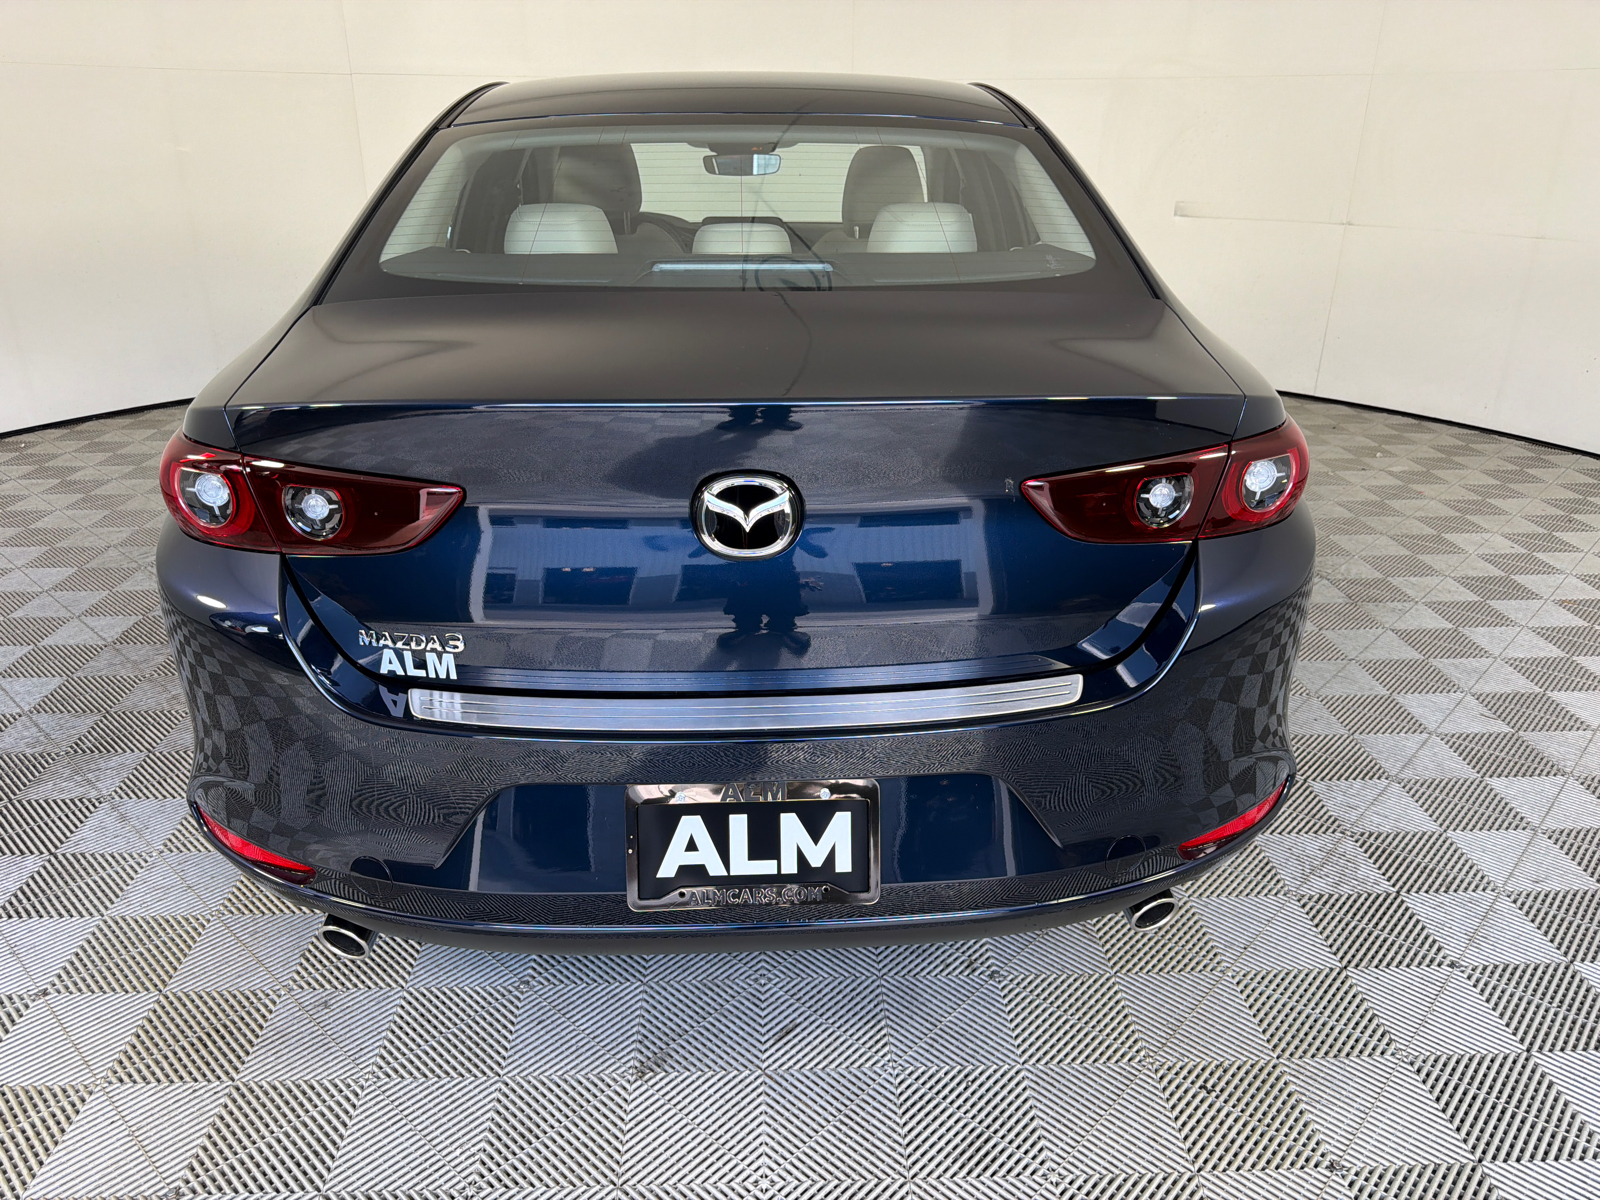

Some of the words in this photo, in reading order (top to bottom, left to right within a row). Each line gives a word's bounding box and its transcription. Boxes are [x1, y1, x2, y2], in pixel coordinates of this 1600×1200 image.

[358, 629, 466, 653] MAZDA3
[380, 648, 458, 680] ALM
[720, 782, 787, 802] ALM
[656, 811, 852, 878] ALM
[689, 886, 823, 906] ALMCARS.COM
